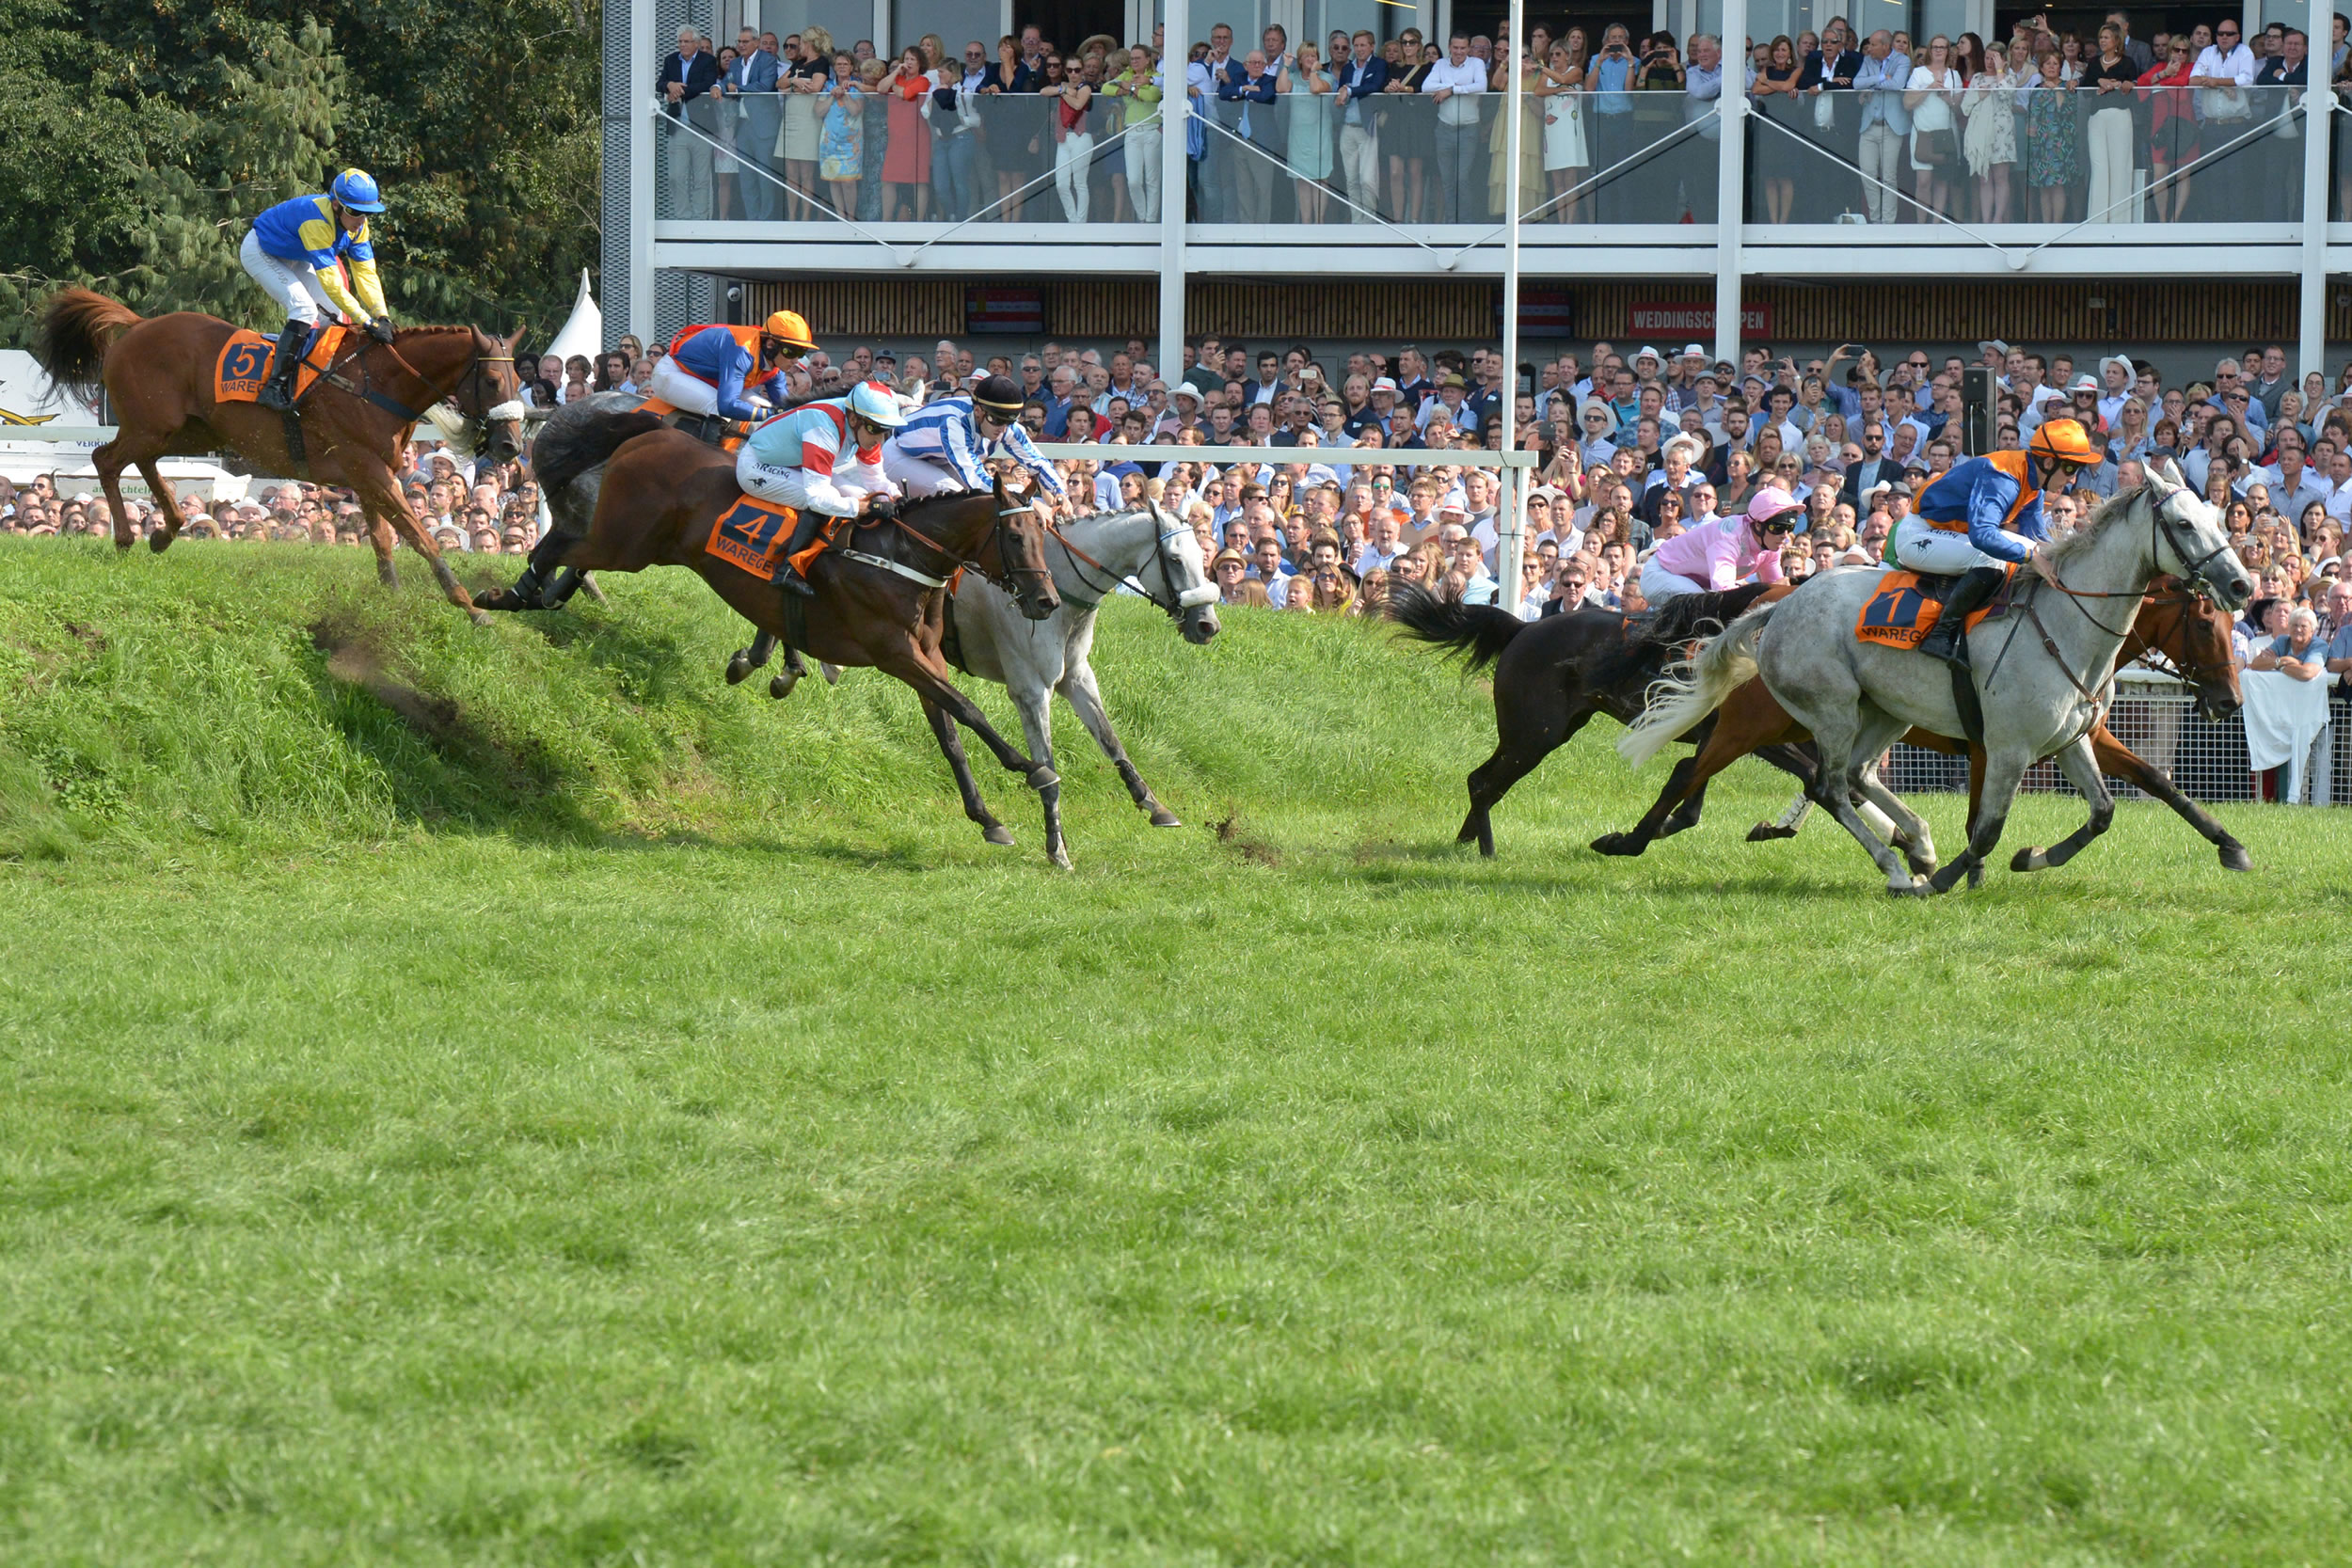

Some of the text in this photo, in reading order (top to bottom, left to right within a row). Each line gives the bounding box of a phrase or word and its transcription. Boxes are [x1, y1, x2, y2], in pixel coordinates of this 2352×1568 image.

[1633, 310, 1765, 329] WEDDINGSCPEN
[231, 344, 261, 377] 5
[734, 514, 769, 546] 4
[1886, 589, 1906, 624] 1
